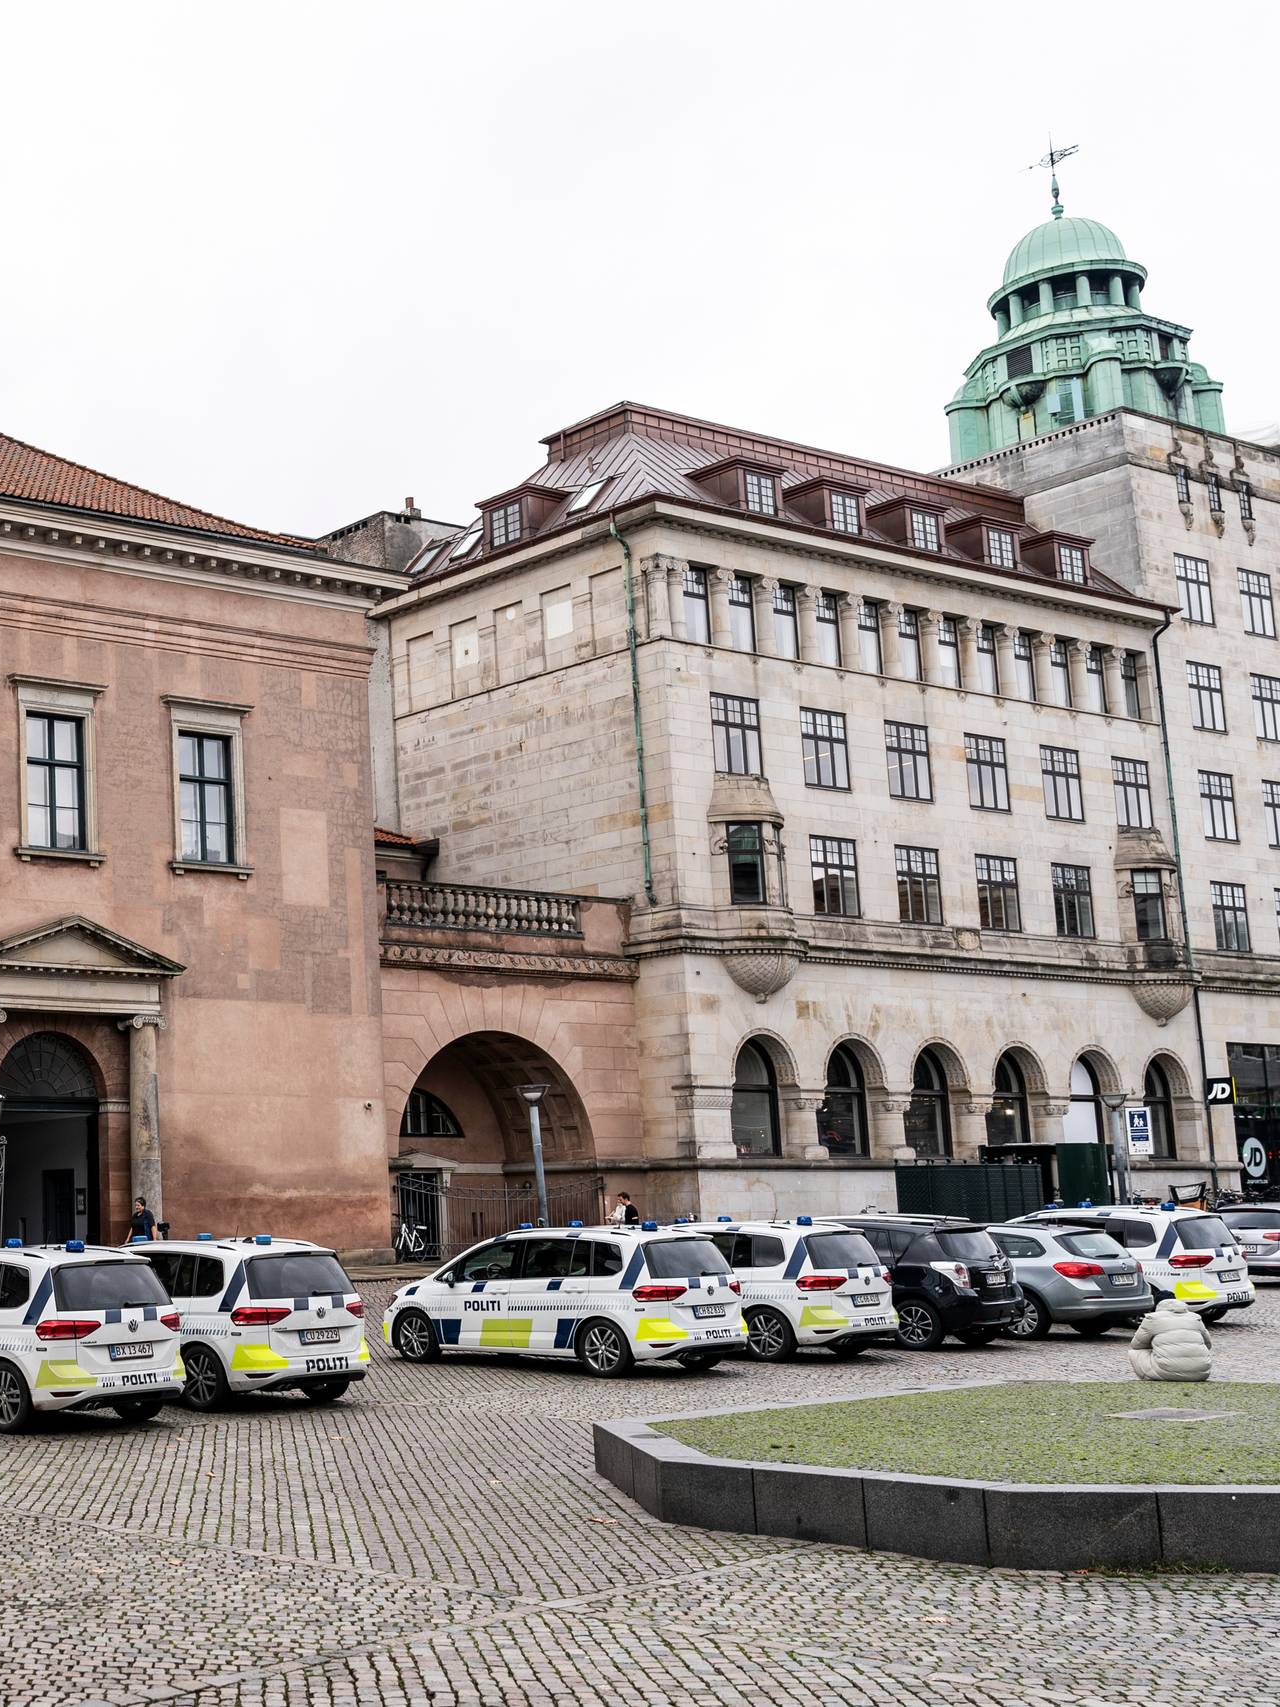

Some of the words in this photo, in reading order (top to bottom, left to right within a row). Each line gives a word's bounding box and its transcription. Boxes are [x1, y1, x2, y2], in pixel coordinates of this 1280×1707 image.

[1207, 1083, 1231, 1100] JD
[1247, 1147, 1263, 1167] JD
[1226, 1291, 1250, 1302] POLITI
[464, 1300, 501, 1311] POLITI
[864, 1316, 887, 1326] POLITI
[305, 1331, 315, 1340] CU
[315, 1330, 325, 1339] 29
[325, 1329, 338, 1339] 229
[706, 1329, 732, 1339] POLITI
[115, 1345, 126, 1356] BX
[127, 1344, 137, 1355] 13
[138, 1344, 150, 1354] 467
[305, 1356, 349, 1372] POLITI
[122, 1372, 158, 1386] POLITI
